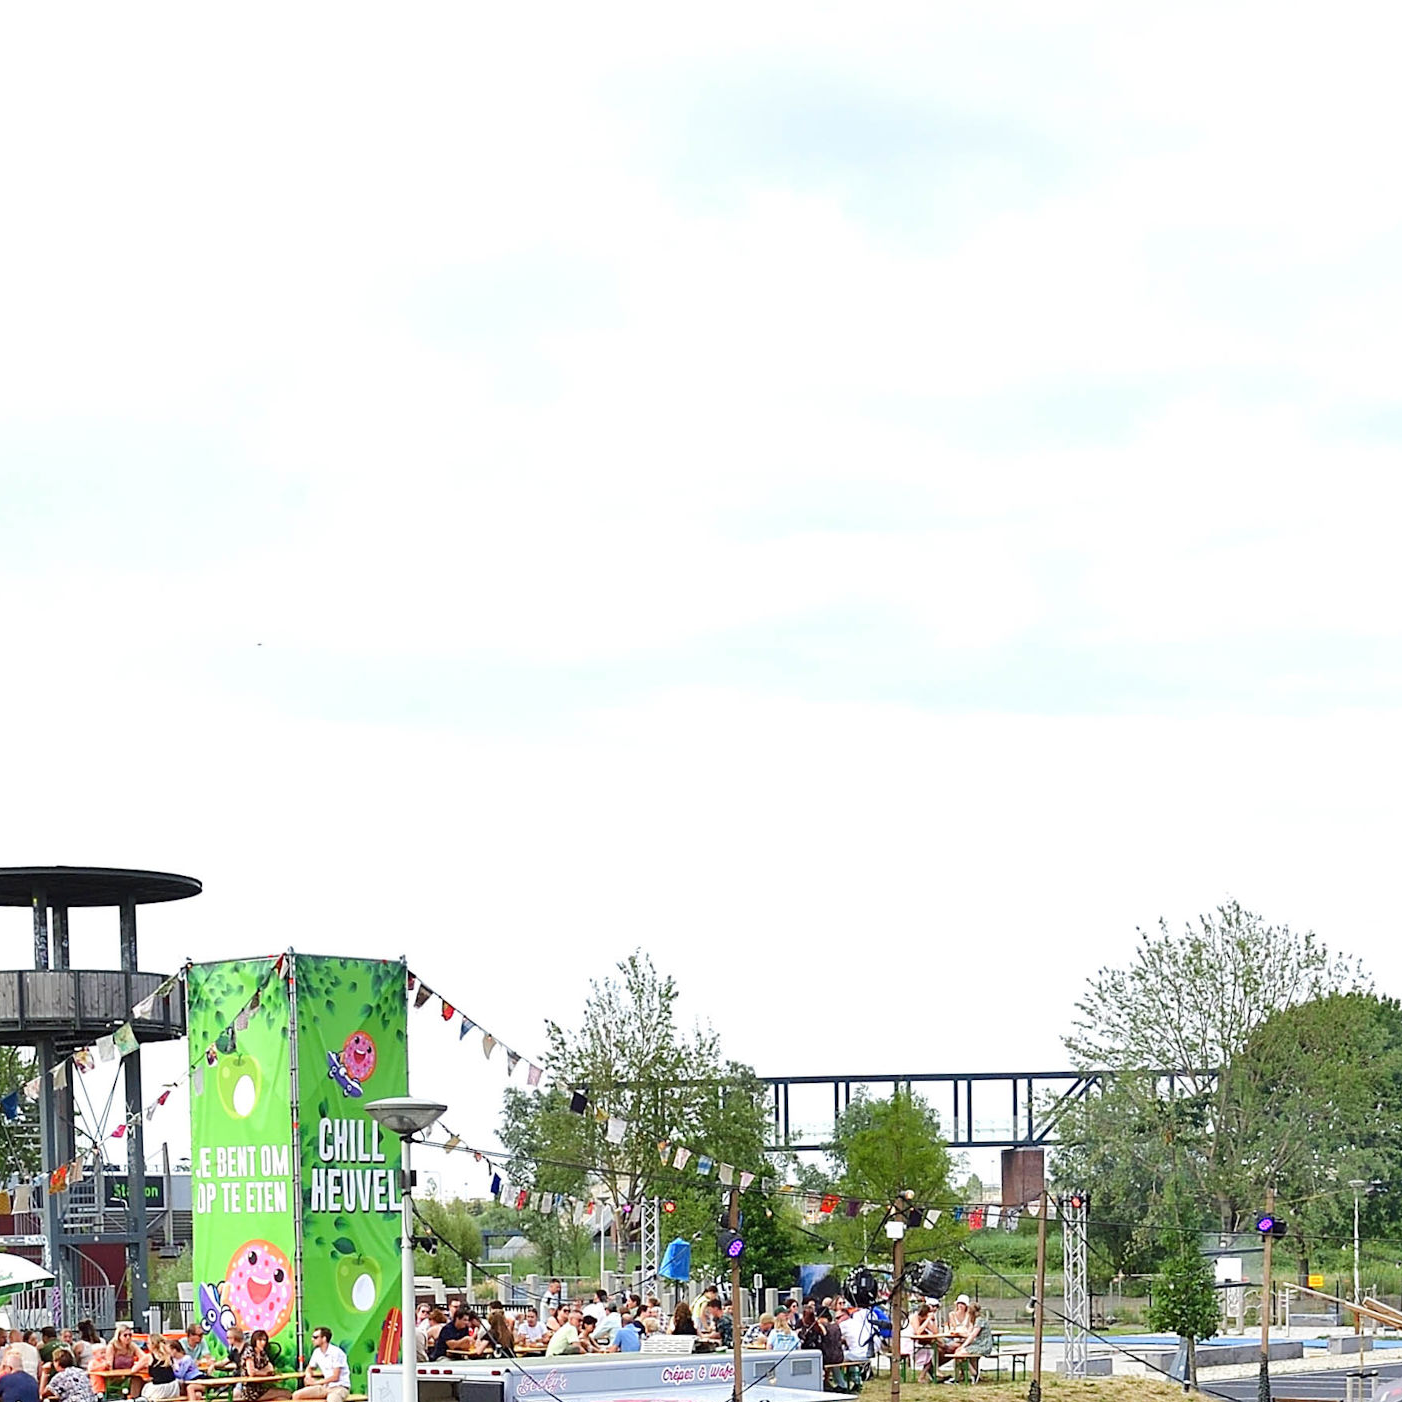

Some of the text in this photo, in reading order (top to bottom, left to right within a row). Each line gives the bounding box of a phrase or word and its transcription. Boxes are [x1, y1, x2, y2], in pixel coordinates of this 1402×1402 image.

[319, 1117, 385, 1163] CHILL
[216, 1146, 256, 1178] BENT
[261, 1144, 290, 1176] OM
[197, 1181, 287, 1214] OP TE ETEN
[311, 1168, 403, 1213] HEUVEL
[662, 1364, 695, 1385] Crêpes
[710, 1363, 735, 1381] Wafe
